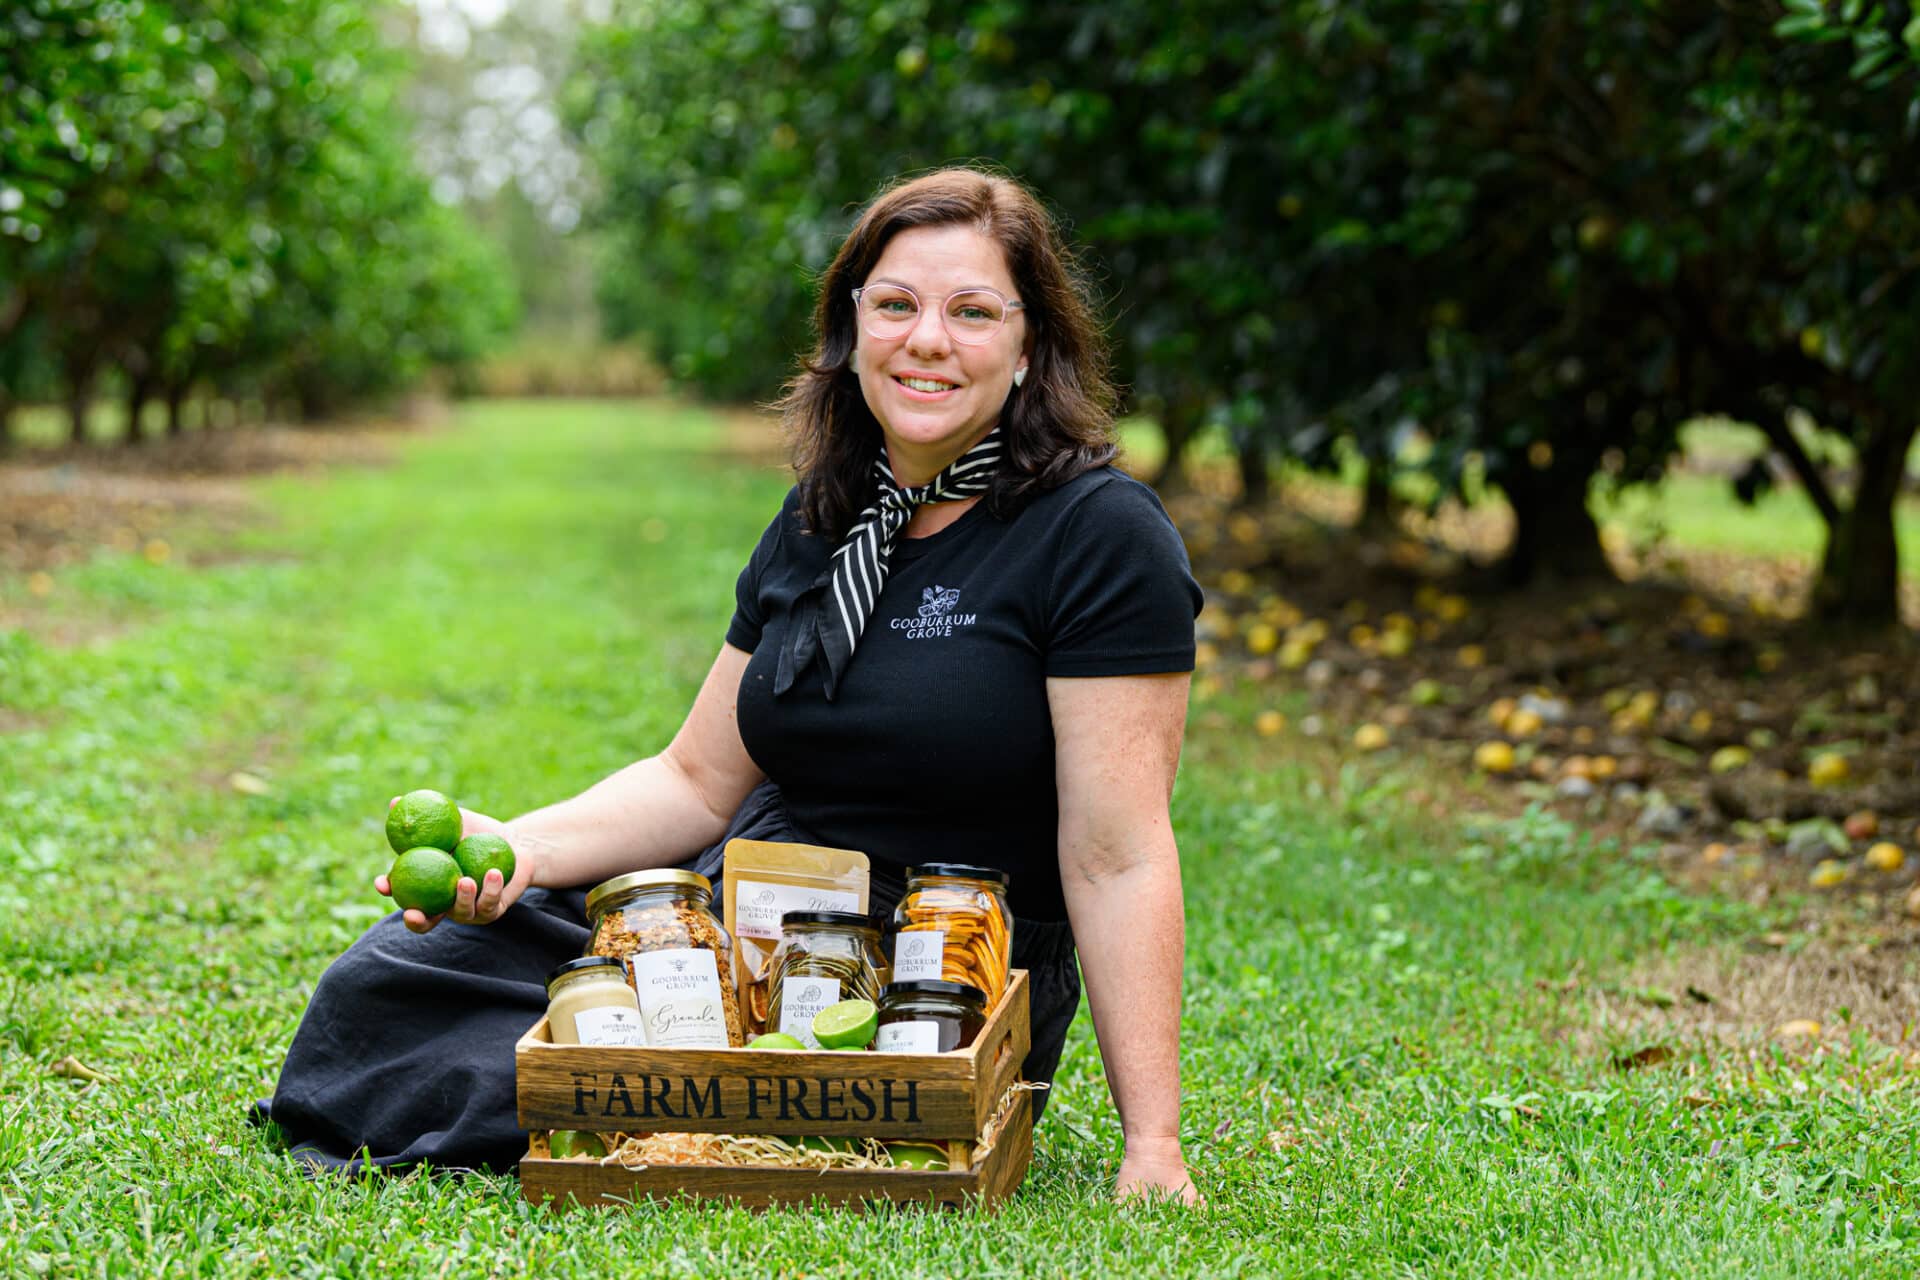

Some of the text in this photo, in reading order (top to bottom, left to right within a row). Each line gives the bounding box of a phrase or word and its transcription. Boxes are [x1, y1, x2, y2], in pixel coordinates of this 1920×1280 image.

[890, 613, 976, 630] GOOBURRUM
[906, 625, 953, 639] GROVE
[651, 975, 709, 985] GOOBURRUM
[665, 983, 696, 991] GROVE
[784, 1003, 825, 1012] GOOBURR
[650, 1003, 717, 1034] Granola
[570, 1072, 923, 1123] FARM FRESH
